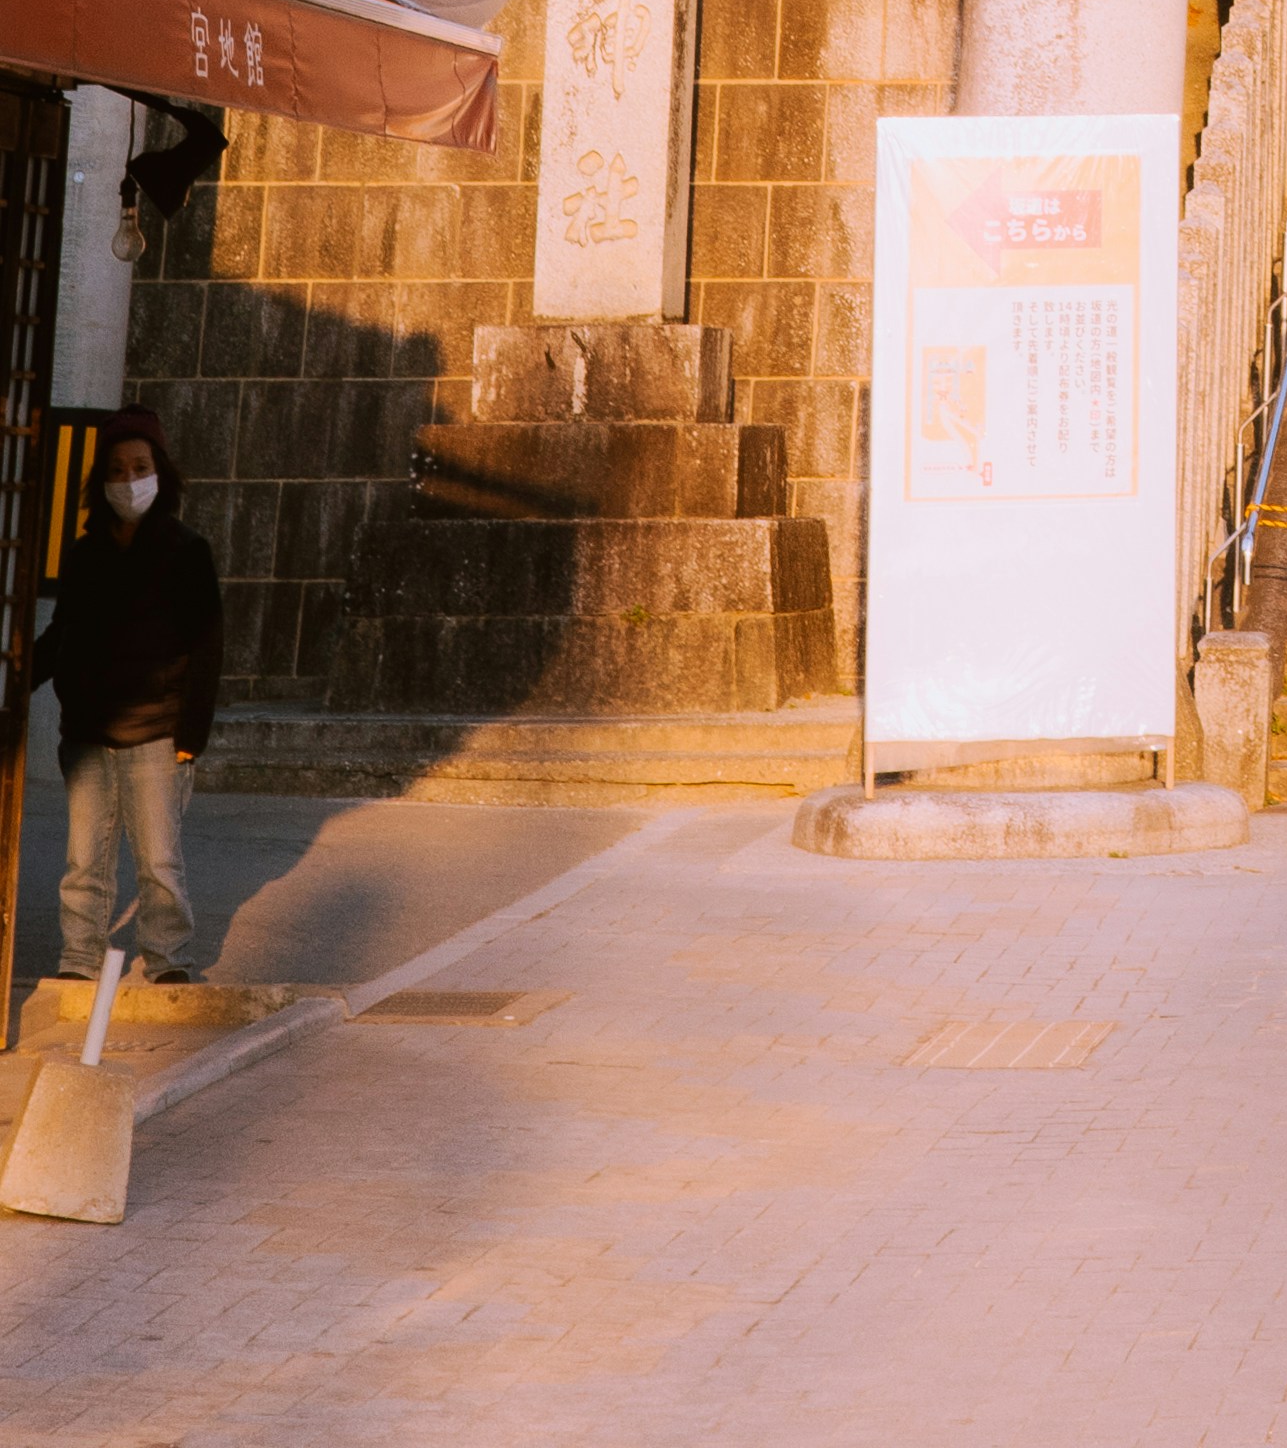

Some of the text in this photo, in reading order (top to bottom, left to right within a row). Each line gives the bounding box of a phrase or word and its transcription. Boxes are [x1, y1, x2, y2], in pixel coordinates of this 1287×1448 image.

[191, 6, 264, 87] 宮地館
[1008, 196, 1061, 216] 坂道は
[983, 219, 1087, 243] こちらから
